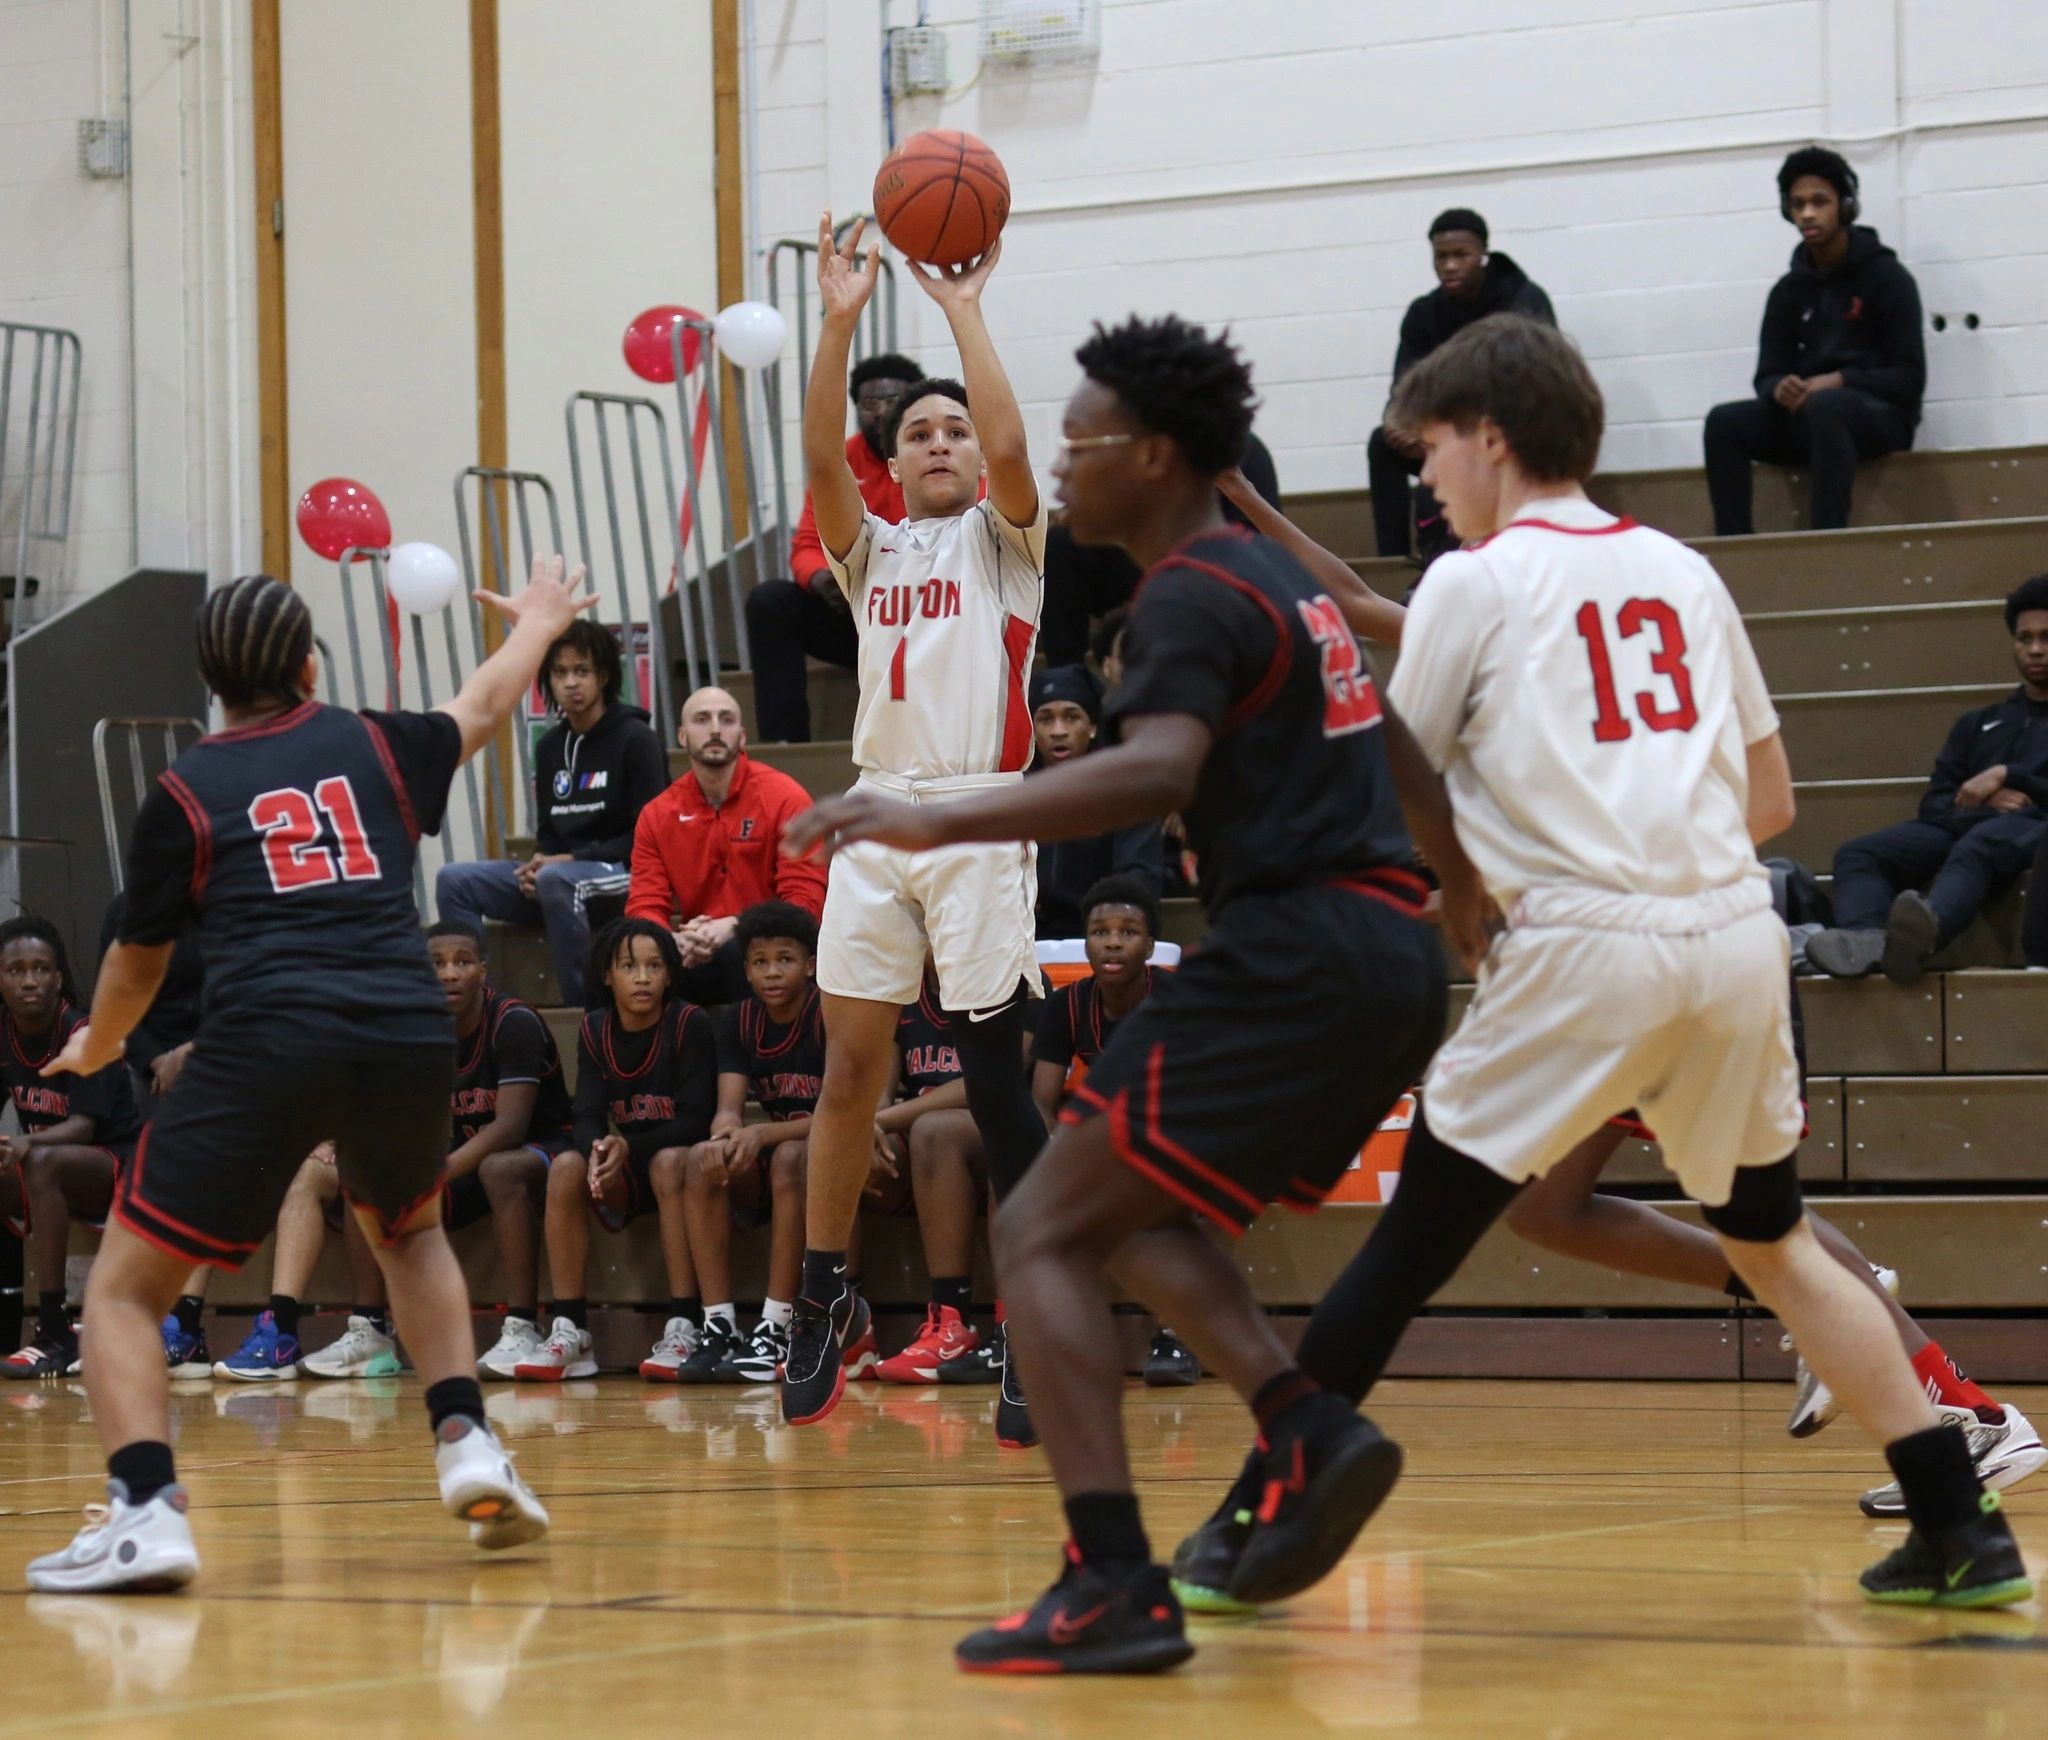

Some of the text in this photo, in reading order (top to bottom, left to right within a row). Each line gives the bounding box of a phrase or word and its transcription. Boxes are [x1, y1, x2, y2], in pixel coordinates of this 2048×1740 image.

[890, 635, 907, 702] 1
[1576, 596, 1698, 743] 13
[247, 774, 382, 893] 21
[740, 817, 755, 840] F
[905, 1045, 962, 1076] ALC
